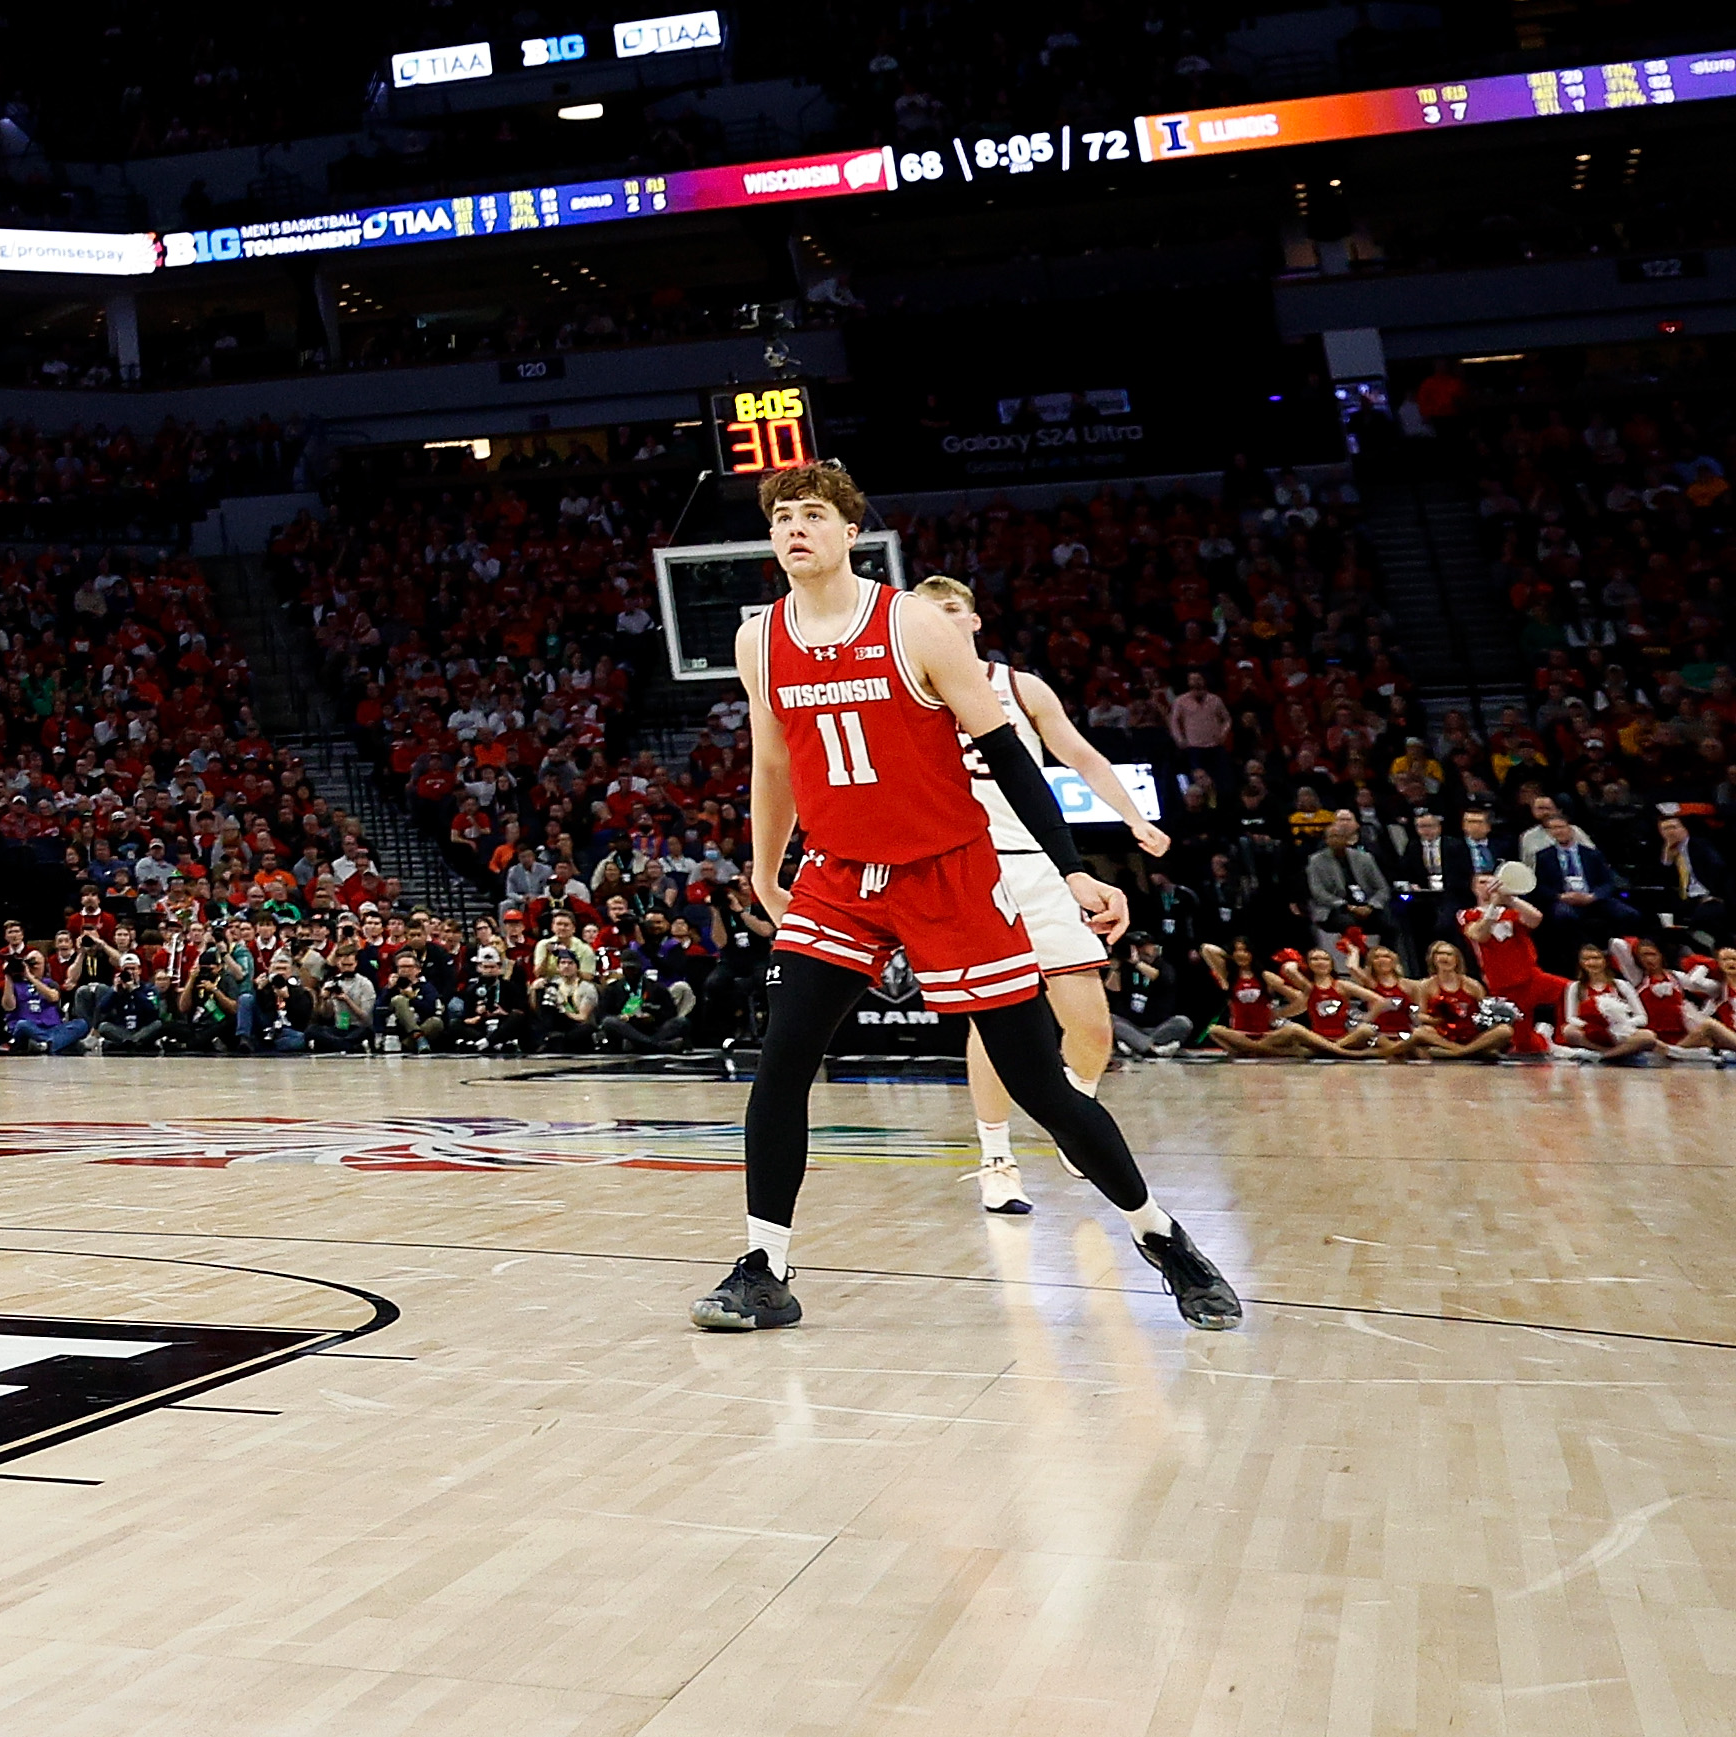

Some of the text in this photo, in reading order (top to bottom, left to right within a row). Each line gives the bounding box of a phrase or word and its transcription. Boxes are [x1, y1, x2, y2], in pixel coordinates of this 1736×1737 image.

[650, 21, 714, 46] TIAA
[426, 53, 486, 77] TIAA
[1422, 105, 1442, 124] 3
[1449, 102, 1468, 121] 7
[1198, 113, 1280, 144] ILLINOIS
[974, 132, 1054, 169] 8:05
[1082, 130, 1130, 162] 72
[742, 164, 840, 196] WISCONSIN
[900, 150, 944, 183] 68
[627, 194, 640, 213] 2
[652, 193, 667, 210] 5
[240, 213, 362, 239] MEN'S BASKETBALL
[387, 206, 453, 236] TIAA
[241, 229, 363, 258] TOURNAMENT
[515, 360, 547, 379] 120
[734, 387, 804, 422] 8:05
[726, 418, 804, 472] 30
[941, 422, 1146, 456] Galaxy S24 Ultra
[776, 677, 892, 710] WISCONSIN
[816, 710, 878, 787] 11
[857, 1010, 940, 1025] RAM
